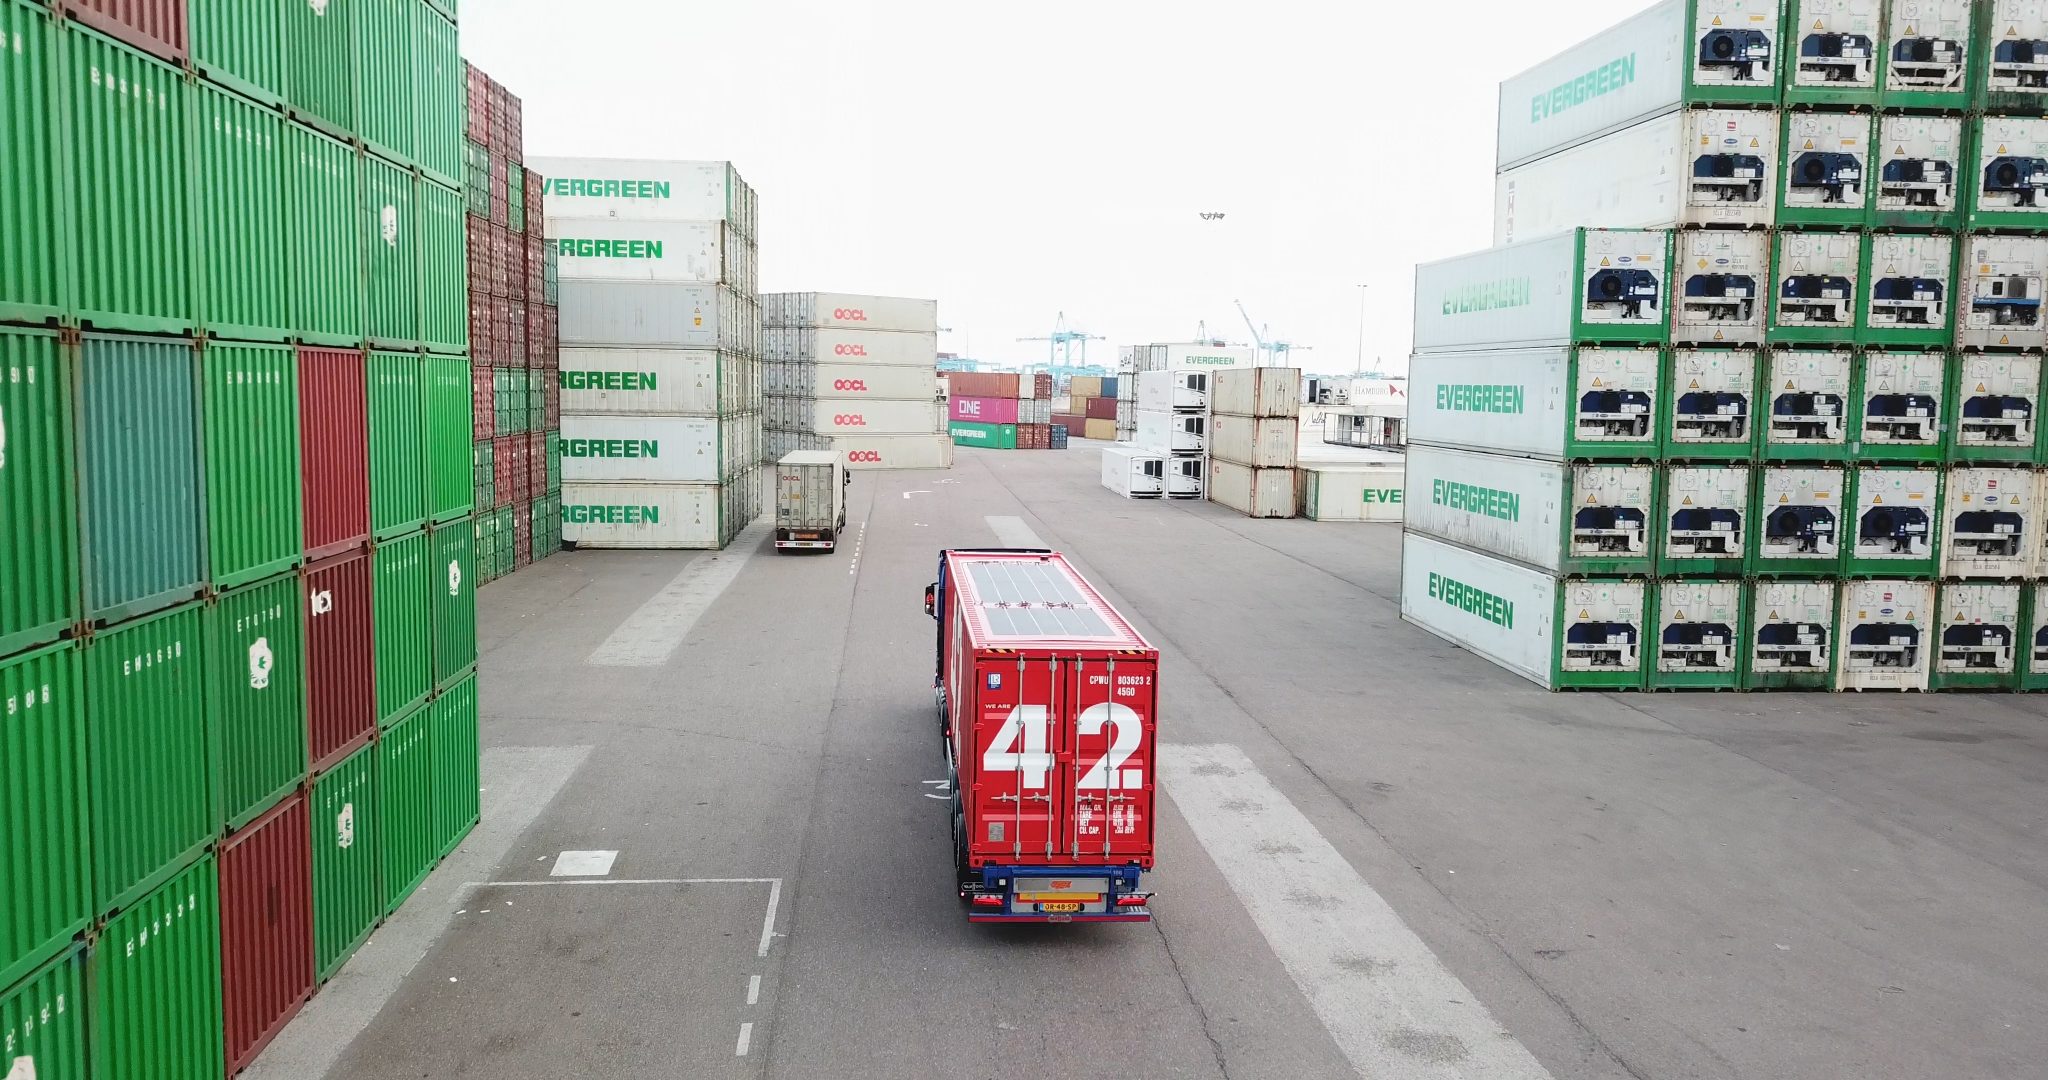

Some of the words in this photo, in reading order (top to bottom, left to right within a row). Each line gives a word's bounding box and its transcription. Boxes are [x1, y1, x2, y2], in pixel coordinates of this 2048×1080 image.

[1531, 52, 1636, 123] EVERGREEN
[544, 238, 662, 259] RGREEN
[834, 308, 867, 321] OOCL
[834, 344, 867, 356] OOCL
[1186, 356, 1235, 365] EVERGREEN
[834, 379, 867, 391] OOCL
[1436, 384, 1524, 414] EVERGREEN
[959, 399, 981, 415] ONE
[834, 414, 866, 426] OOCL
[952, 428, 987, 439] EVERGREEN
[848, 450, 881, 462] OOCL
[1433, 478, 1519, 523] EVERGREEN
[1429, 571, 1514, 630] EVERGREEN
[1089, 675, 1109, 685] CPWU
[1117, 675, 1144, 685] 803623
